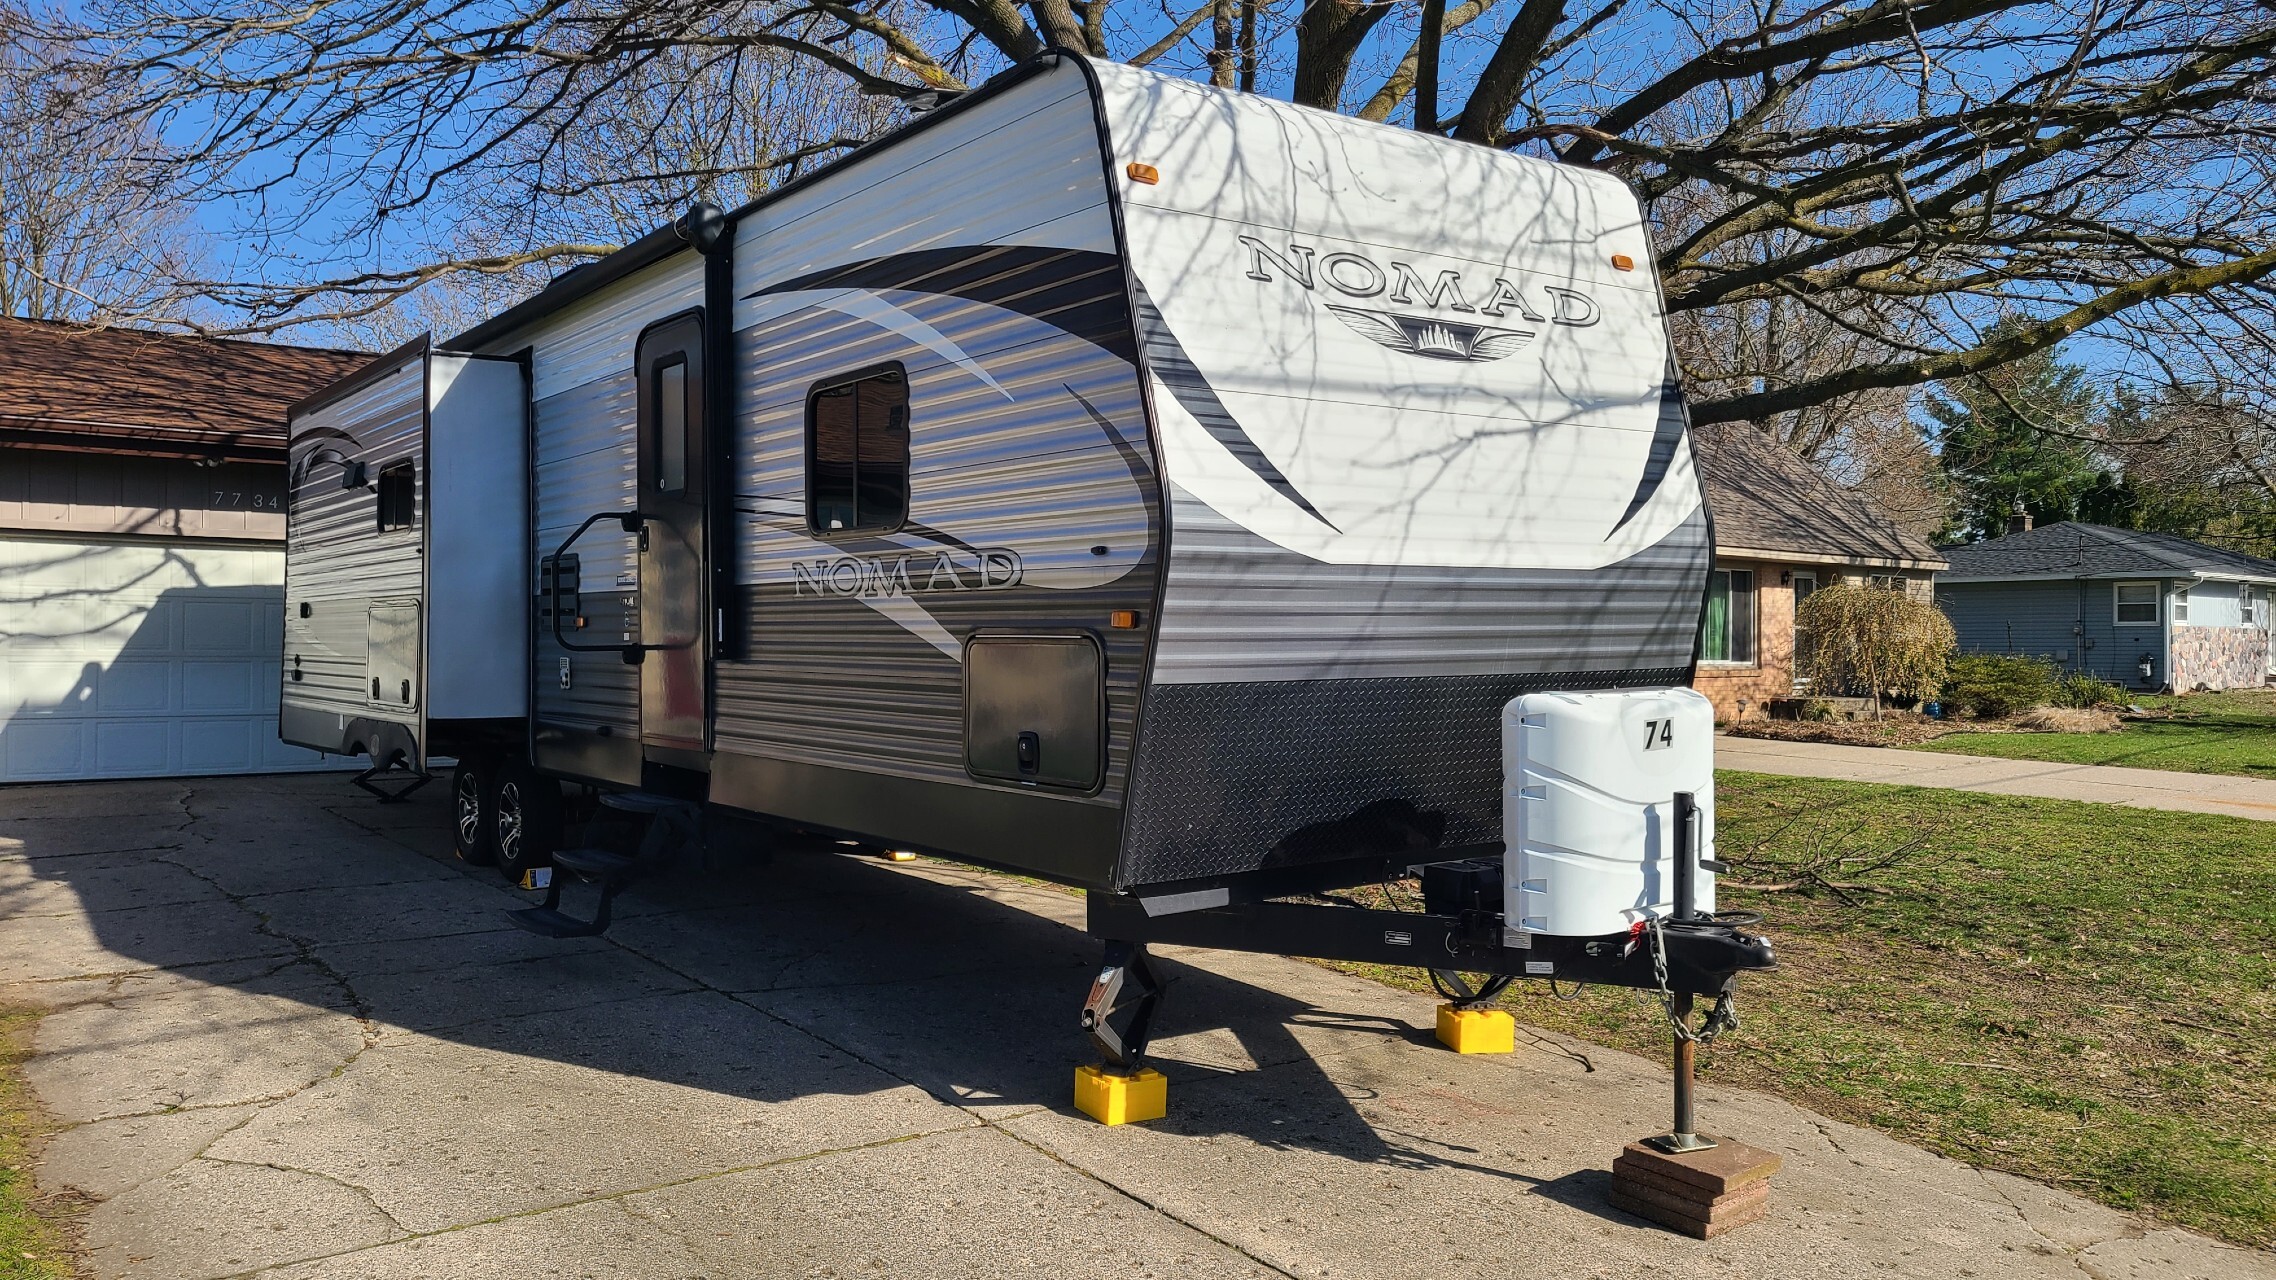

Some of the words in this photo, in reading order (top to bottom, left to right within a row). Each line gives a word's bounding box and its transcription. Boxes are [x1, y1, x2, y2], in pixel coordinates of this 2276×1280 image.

[1238, 235, 1601, 328] NOMAD
[215, 491, 278, 509] 7734
[792, 546, 1024, 599] NOMAD
[1645, 719, 1673, 750] 74
